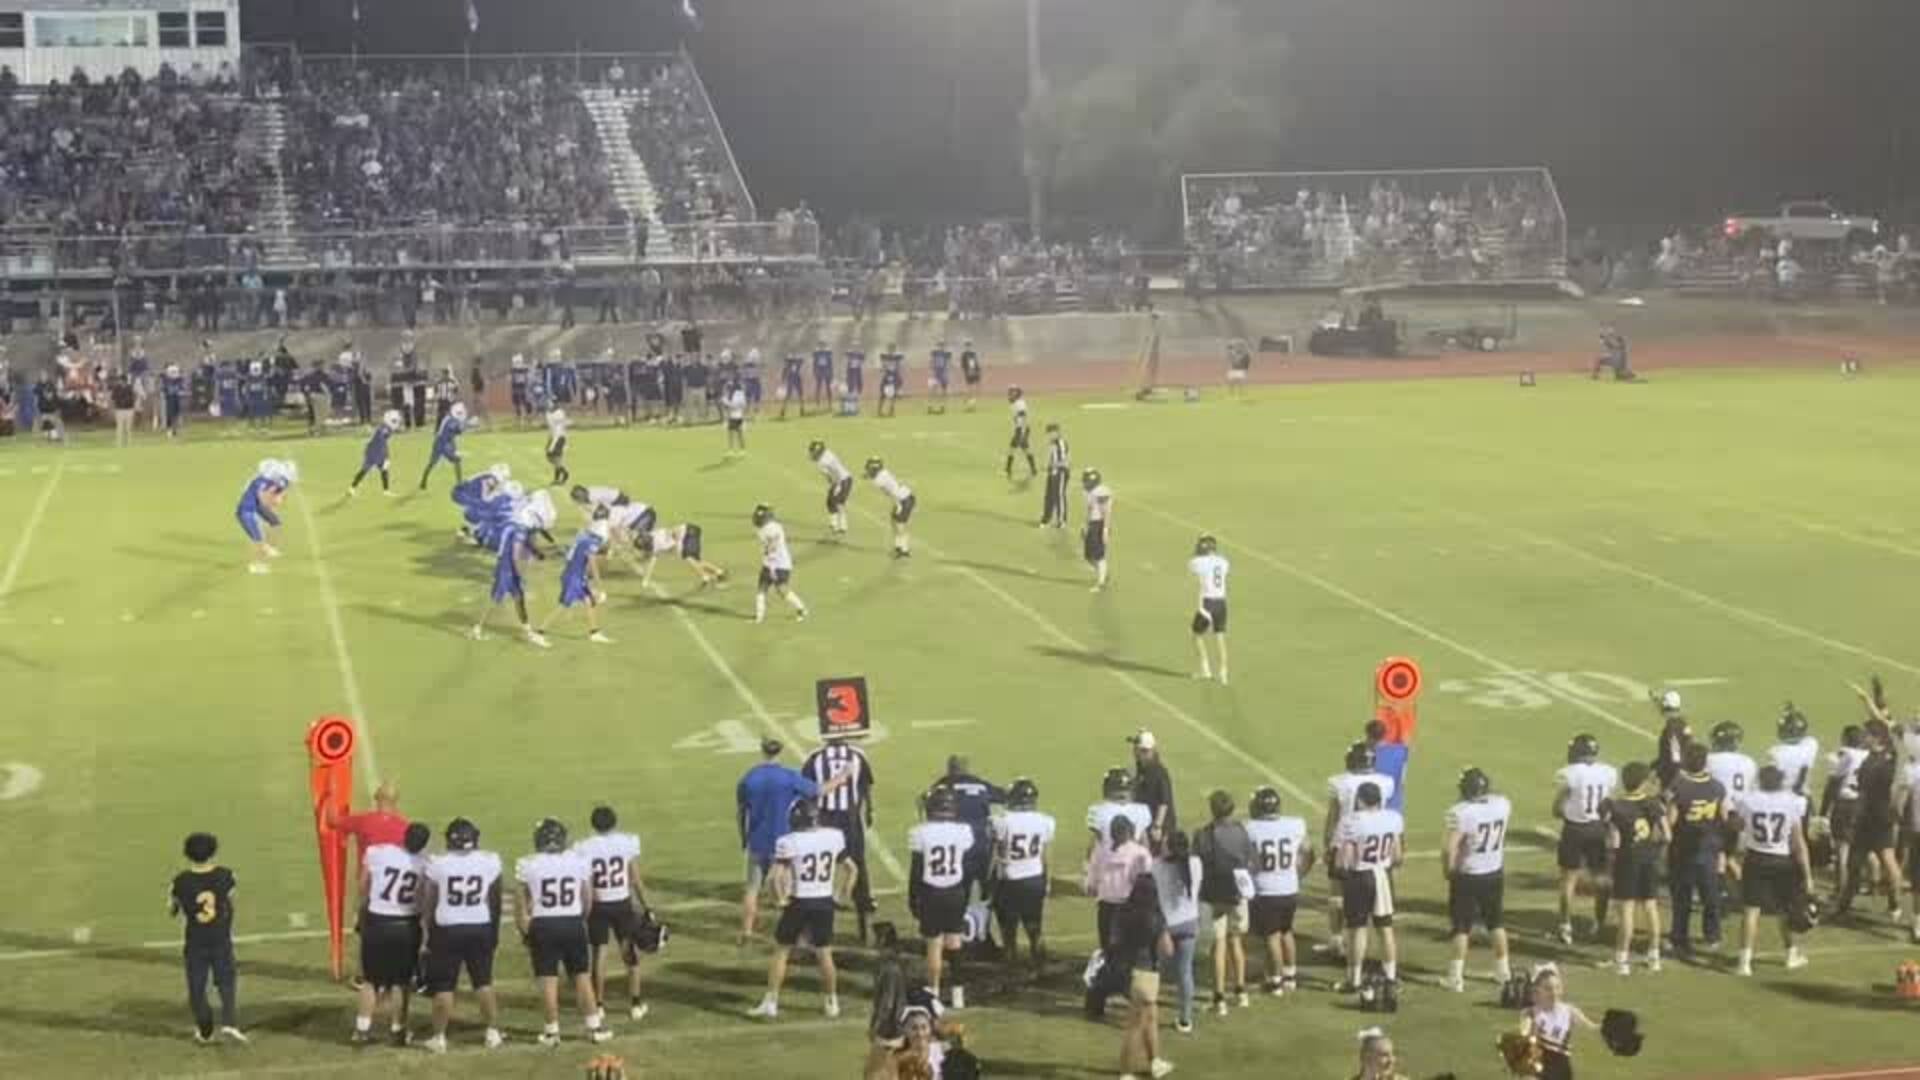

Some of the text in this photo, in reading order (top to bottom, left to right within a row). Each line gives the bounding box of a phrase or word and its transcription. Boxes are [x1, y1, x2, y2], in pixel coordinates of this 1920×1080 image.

[826, 685, 860, 725] 3
[1584, 785, 1604, 814] 11
[1475, 821, 1504, 853] 77
[1752, 813, 1786, 843] 57
[930, 845, 956, 876] 21
[1261, 837, 1292, 872] 66
[1362, 832, 1393, 864] 20
[592, 856, 624, 888] 22
[801, 850, 834, 882] 33
[381, 867, 417, 904] 72
[447, 875, 482, 907] 52
[541, 877, 575, 908] 56
[195, 890, 217, 924] 3
